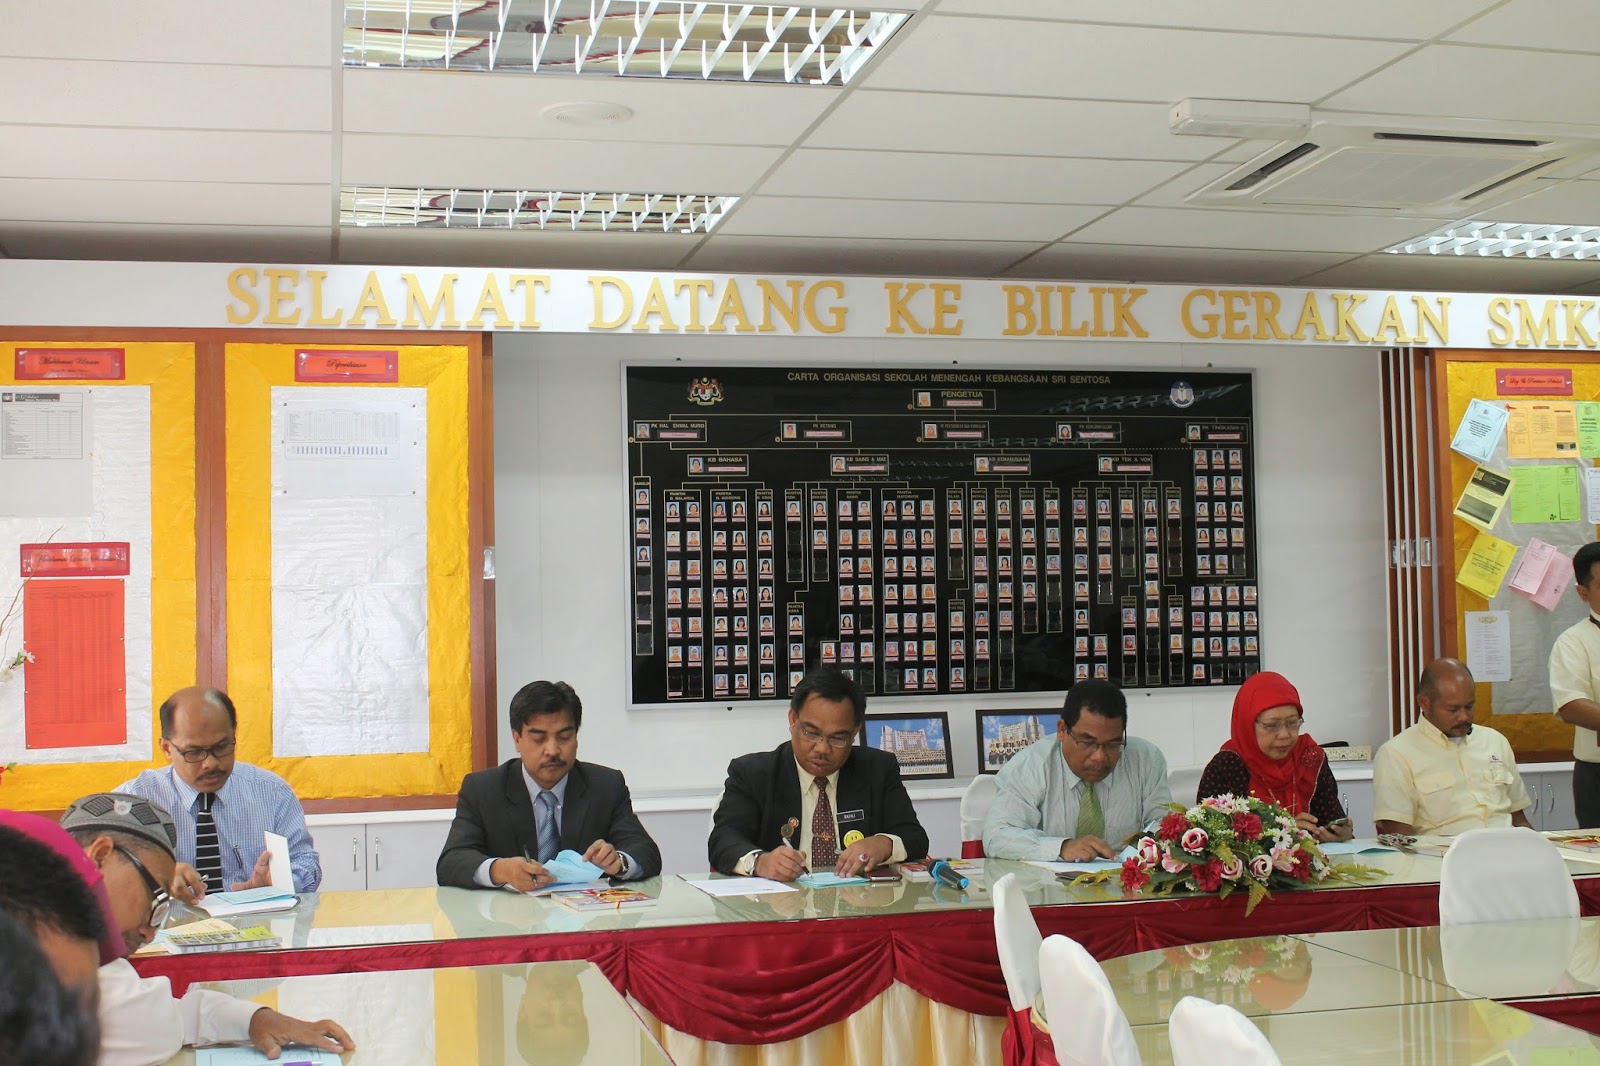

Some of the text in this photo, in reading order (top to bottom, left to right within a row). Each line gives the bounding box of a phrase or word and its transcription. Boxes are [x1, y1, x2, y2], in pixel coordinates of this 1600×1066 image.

[226, 266, 1600, 347] SELAMAT DATANG KE BILIK GERAKAN SMK
[787, 372, 1111, 384] CARTA ORGANISASI SEKOLAH MENENGAH KEBANGSAAN SRI SENTOSA
